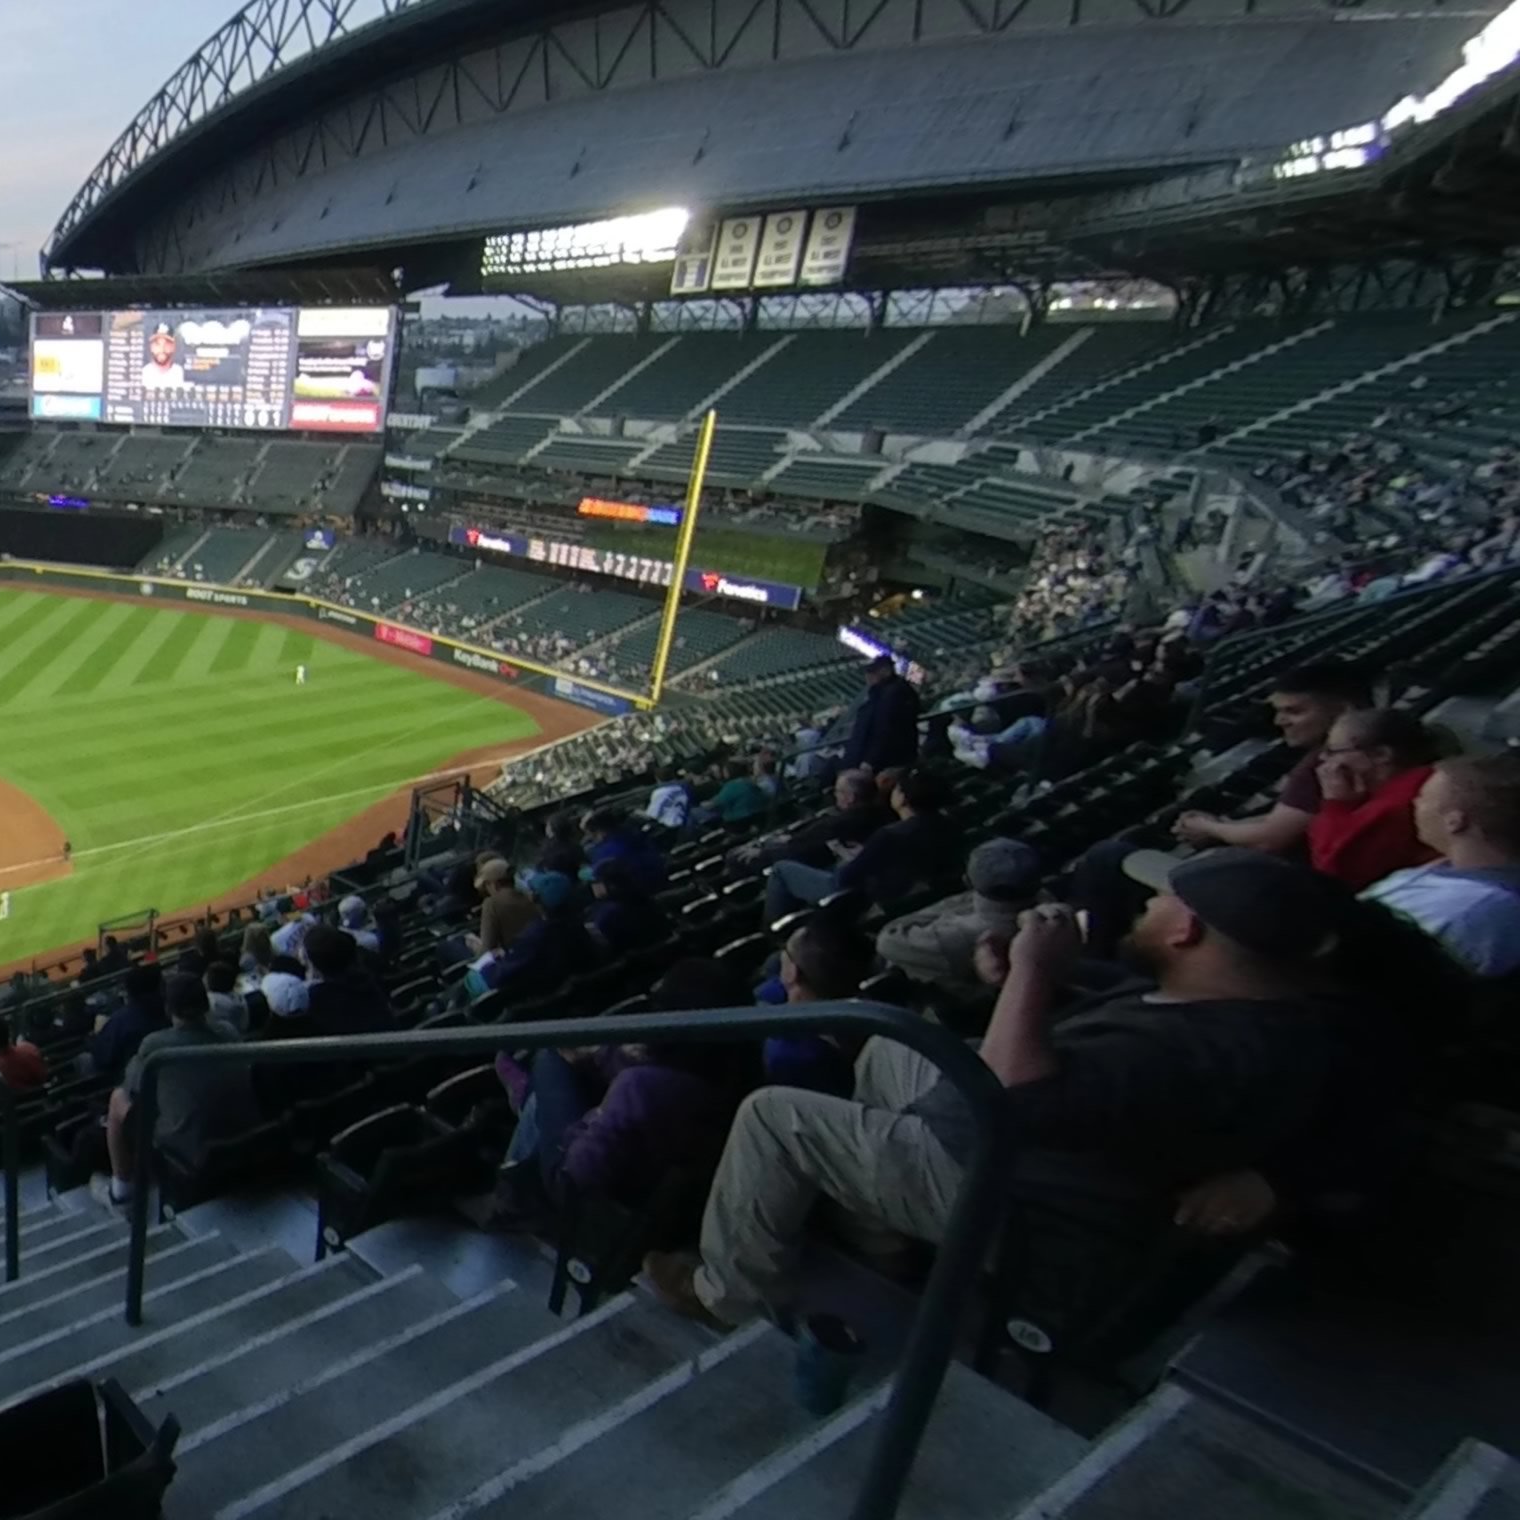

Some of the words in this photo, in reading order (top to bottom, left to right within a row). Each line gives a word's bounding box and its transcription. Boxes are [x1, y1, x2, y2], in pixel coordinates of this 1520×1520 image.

[478, 533, 511, 552] Fanatics
[186, 588, 213, 601] ROOT
[214, 592, 248, 605] SPORTS
[718, 579, 768, 602] Fanatics
[454, 648, 498, 673] KeyBank
